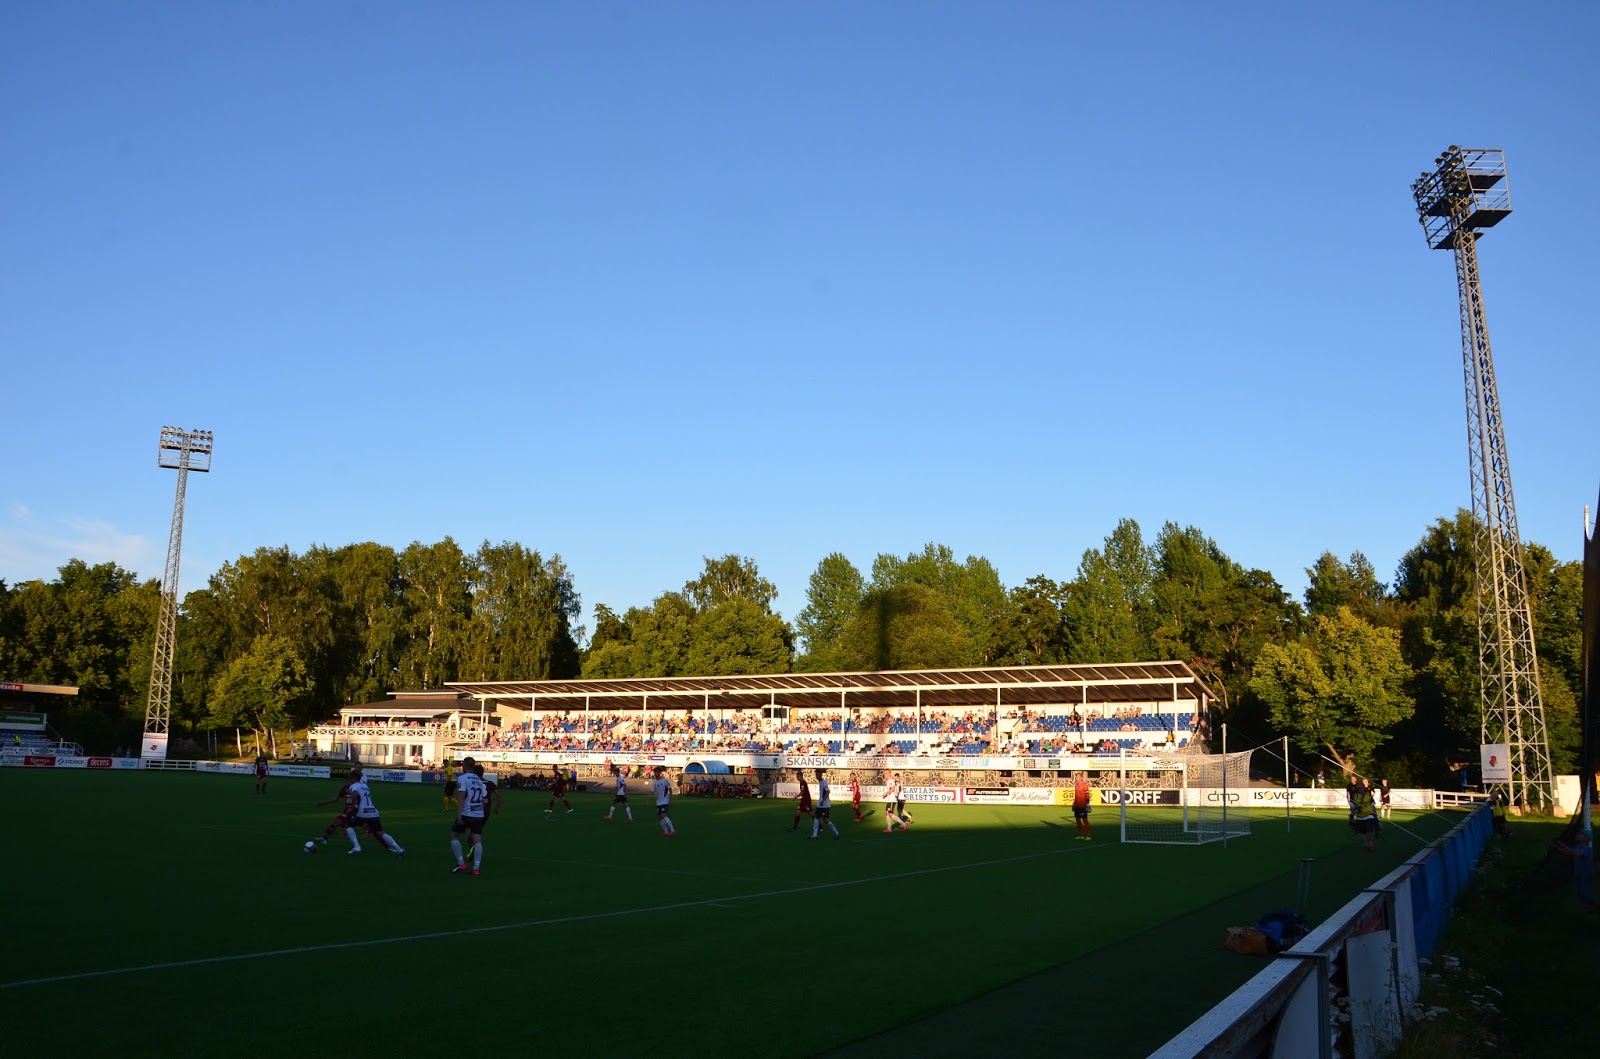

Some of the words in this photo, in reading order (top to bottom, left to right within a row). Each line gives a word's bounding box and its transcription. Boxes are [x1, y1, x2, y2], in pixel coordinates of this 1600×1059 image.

[90, 758, 110, 766] decens
[786, 757, 837, 767] SKANSKA
[470, 787, 482, 803] 22
[941, 795, 952, 803] Oy
